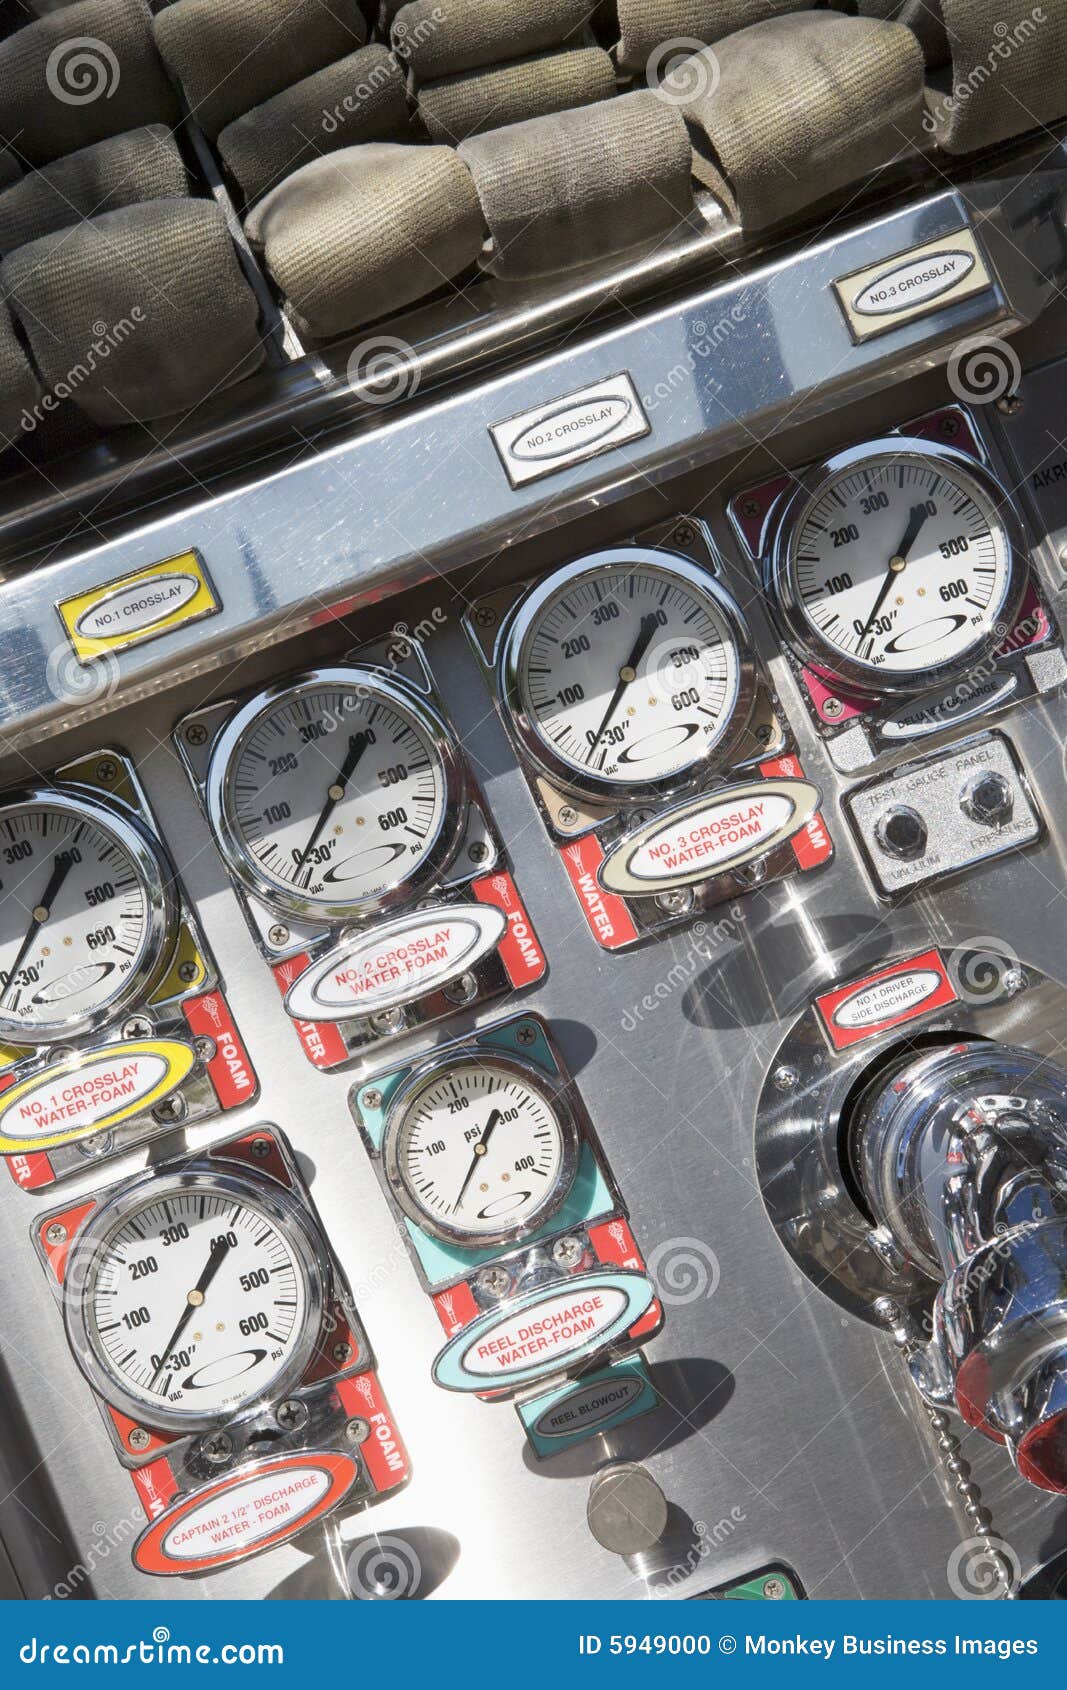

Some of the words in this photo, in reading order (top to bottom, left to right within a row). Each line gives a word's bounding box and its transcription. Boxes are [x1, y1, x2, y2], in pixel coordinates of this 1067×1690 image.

[870, 284, 898, 305] NO.3
[897, 260, 957, 292] CROSSLAY
[527, 433, 553, 449] NO.2
[554, 406, 614, 438] CROSSLAY
[859, 491, 890, 515] 300
[830, 524, 859, 548] 200
[939, 535, 969, 560] 500
[824, 573, 853, 596] 100
[939, 579, 968, 602] 600
[94, 610, 121, 628] NO.1
[123, 585, 183, 617] CROSSLAY
[591, 602, 620, 625] 300
[971, 613, 983, 626] psi
[561, 635, 590, 659] 200
[670, 645, 699, 668] 500
[871, 654, 886, 665] VAC
[556, 684, 584, 706] 100
[671, 688, 700, 711] 600
[299, 720, 328, 743] 300
[704, 722, 716, 735] psi
[268, 753, 298, 776] 200
[377, 764, 408, 788] 500
[604, 765, 618, 776] VAC
[868, 787, 895, 807] TEST
[906, 768, 947, 791] GAUGE
[956, 752, 994, 771] PANEL
[262, 802, 291, 825] 100
[377, 807, 408, 831] 600
[649, 841, 675, 860] NO.
[677, 836, 687, 847] 3
[690, 803, 765, 843] CROSSLAY
[806, 816, 826, 849] AM
[970, 818, 1034, 849] PRESSURE
[4, 840, 33, 865] 300
[410, 842, 422, 855] psi
[664, 822, 762, 870] WATER-FOAM
[891, 854, 940, 880] VACUUM
[84, 882, 116, 907] 500
[309, 884, 324, 894] VAC
[577, 872, 615, 941] WATER
[86, 925, 117, 950] 600
[507, 911, 540, 968] FOAM
[119, 960, 132, 973] psi
[335, 968, 363, 986] NO.
[364, 962, 373, 973] 2
[376, 928, 451, 968] CROSSLAY
[350, 947, 449, 995] WATER-FOAM
[881, 977, 914, 997] DRIVER
[18, 1005, 34, 1016] VAC
[851, 1007, 873, 1021] SIDE
[874, 983, 928, 1012] DISCHARGE
[300, 1021, 325, 1060] TER
[217, 1031, 250, 1090] FOAM
[19, 1102, 48, 1120] NO.
[62, 1062, 140, 1103] CROSSLAY
[34, 1080, 136, 1129] WATER-FOAM
[447, 1096, 470, 1115] 200
[499, 1107, 519, 1126] 300
[464, 1124, 482, 1143] psi
[425, 1140, 446, 1157] 100
[514, 1155, 535, 1173] 400
[159, 1222, 190, 1247] 300
[128, 1256, 158, 1281] 200
[239, 1268, 270, 1292] 500
[122, 1306, 151, 1330] 100
[239, 1312, 269, 1336] 600
[476, 1332, 516, 1360] REEL
[518, 1296, 604, 1343] DISCHARGE
[271, 1347, 284, 1361] psi
[496, 1317, 595, 1368] WATER-FOAM
[168, 1390, 183, 1402] VAC
[550, 1408, 577, 1428] REEL
[578, 1386, 630, 1416] BLOWOUT
[370, 1413, 404, 1471] FOAM
[172, 1520, 221, 1546] CAPTAIN
[254, 1475, 319, 1510] DISCHARGE
[211, 1520, 250, 1544] WATER
[258, 1503, 291, 1526] FOAM
